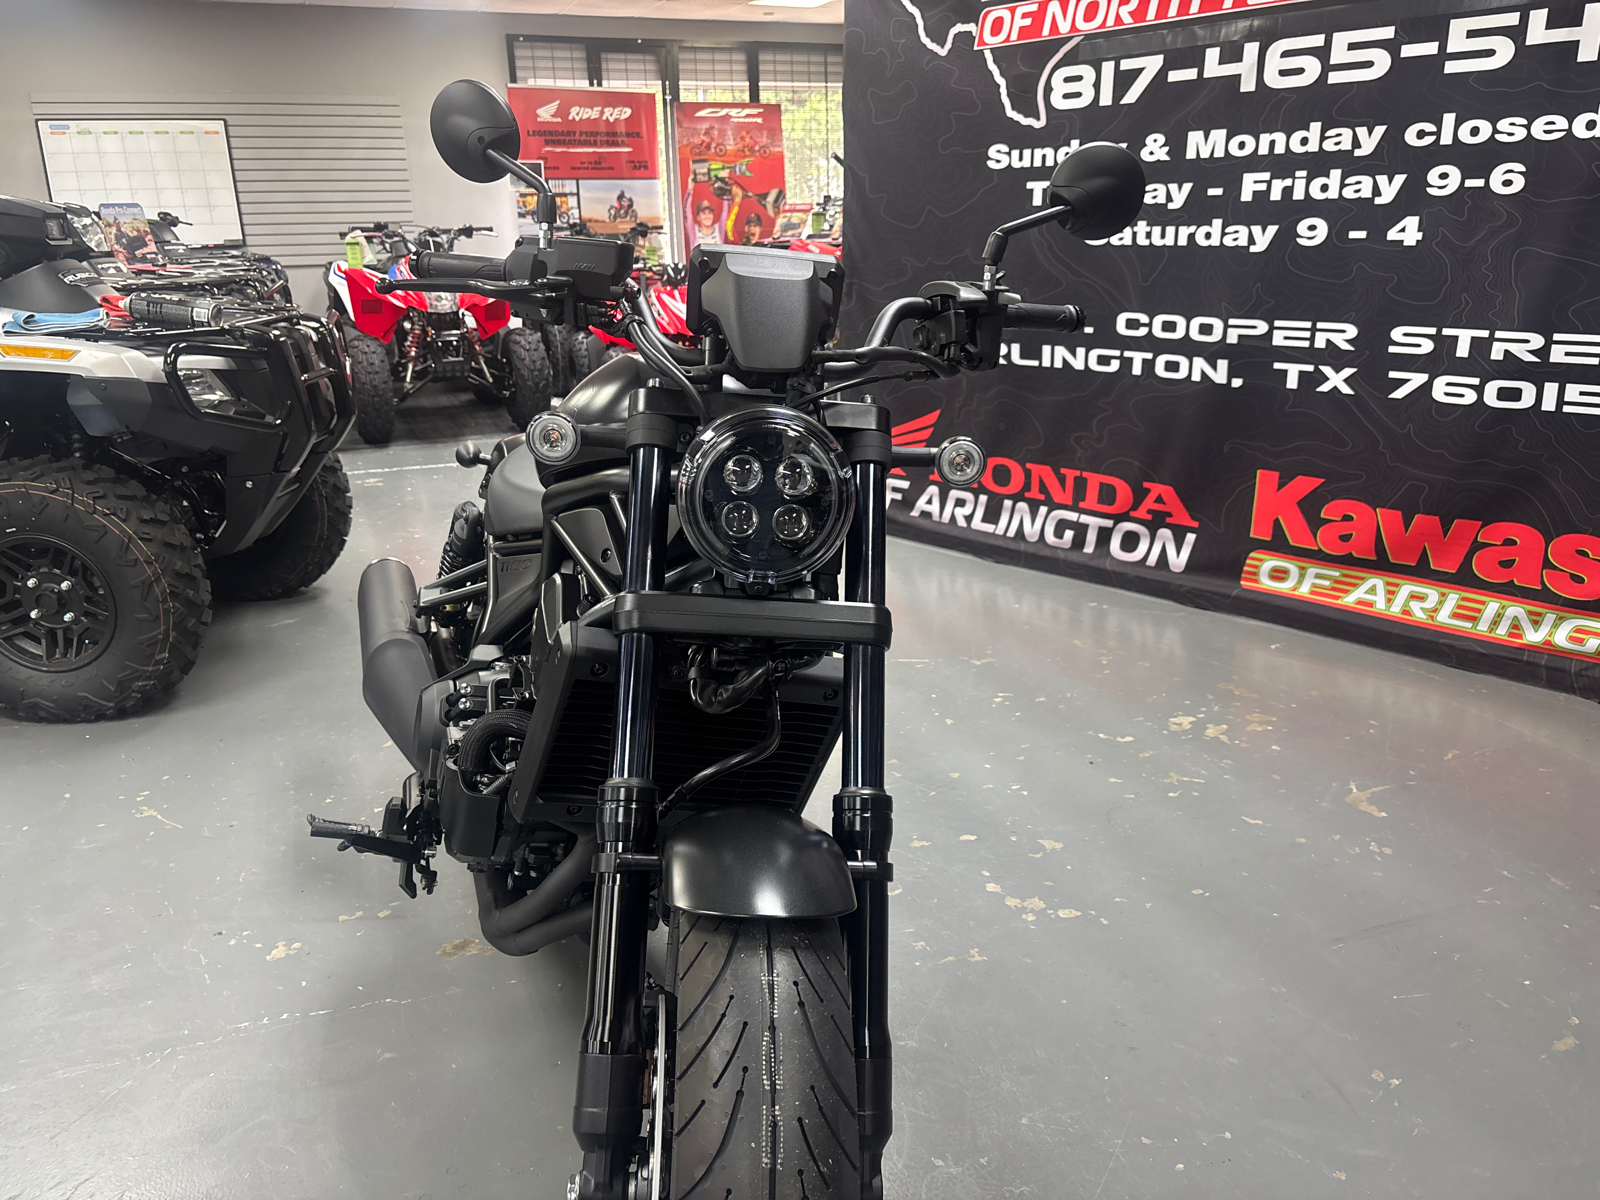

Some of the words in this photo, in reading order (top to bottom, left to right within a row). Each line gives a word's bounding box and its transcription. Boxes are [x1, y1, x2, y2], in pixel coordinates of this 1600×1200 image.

[982, 3, 1039, 45] OF
[1049, 1, 1600, 110] 817-465-54
[568, 105, 602, 122] RIDE
[602, 106, 632, 123] RED
[694, 107, 764, 117] CRF
[1140, 133, 1170, 162] &
[1186, 122, 1388, 160] Monday
[1404, 104, 1600, 147] closed
[527, 129, 577, 138] LEGENDARY
[579, 130, 643, 139] PERFORMANCE.
[544, 138, 598, 147] UNBEATABLE
[1240, 169, 1408, 205] Friday
[1425, 162, 1527, 197] 9-6
[1085, 219, 1279, 252] aturday
[1295, 217, 1328, 247] 9
[1348, 230, 1367, 239] -
[1386, 216, 1423, 246] 4
[1116, 311, 1359, 351] COOPER
[1273, 361, 1358, 395] TX
[1387, 370, 1600, 416] 76015
[929, 457, 1199, 528] ONDA
[910, 485, 1197, 573] ARLINGTON
[1250, 469, 1600, 601] Kawas
[1258, 560, 1340, 594] OF
[1342, 578, 1600, 654] ARLING
